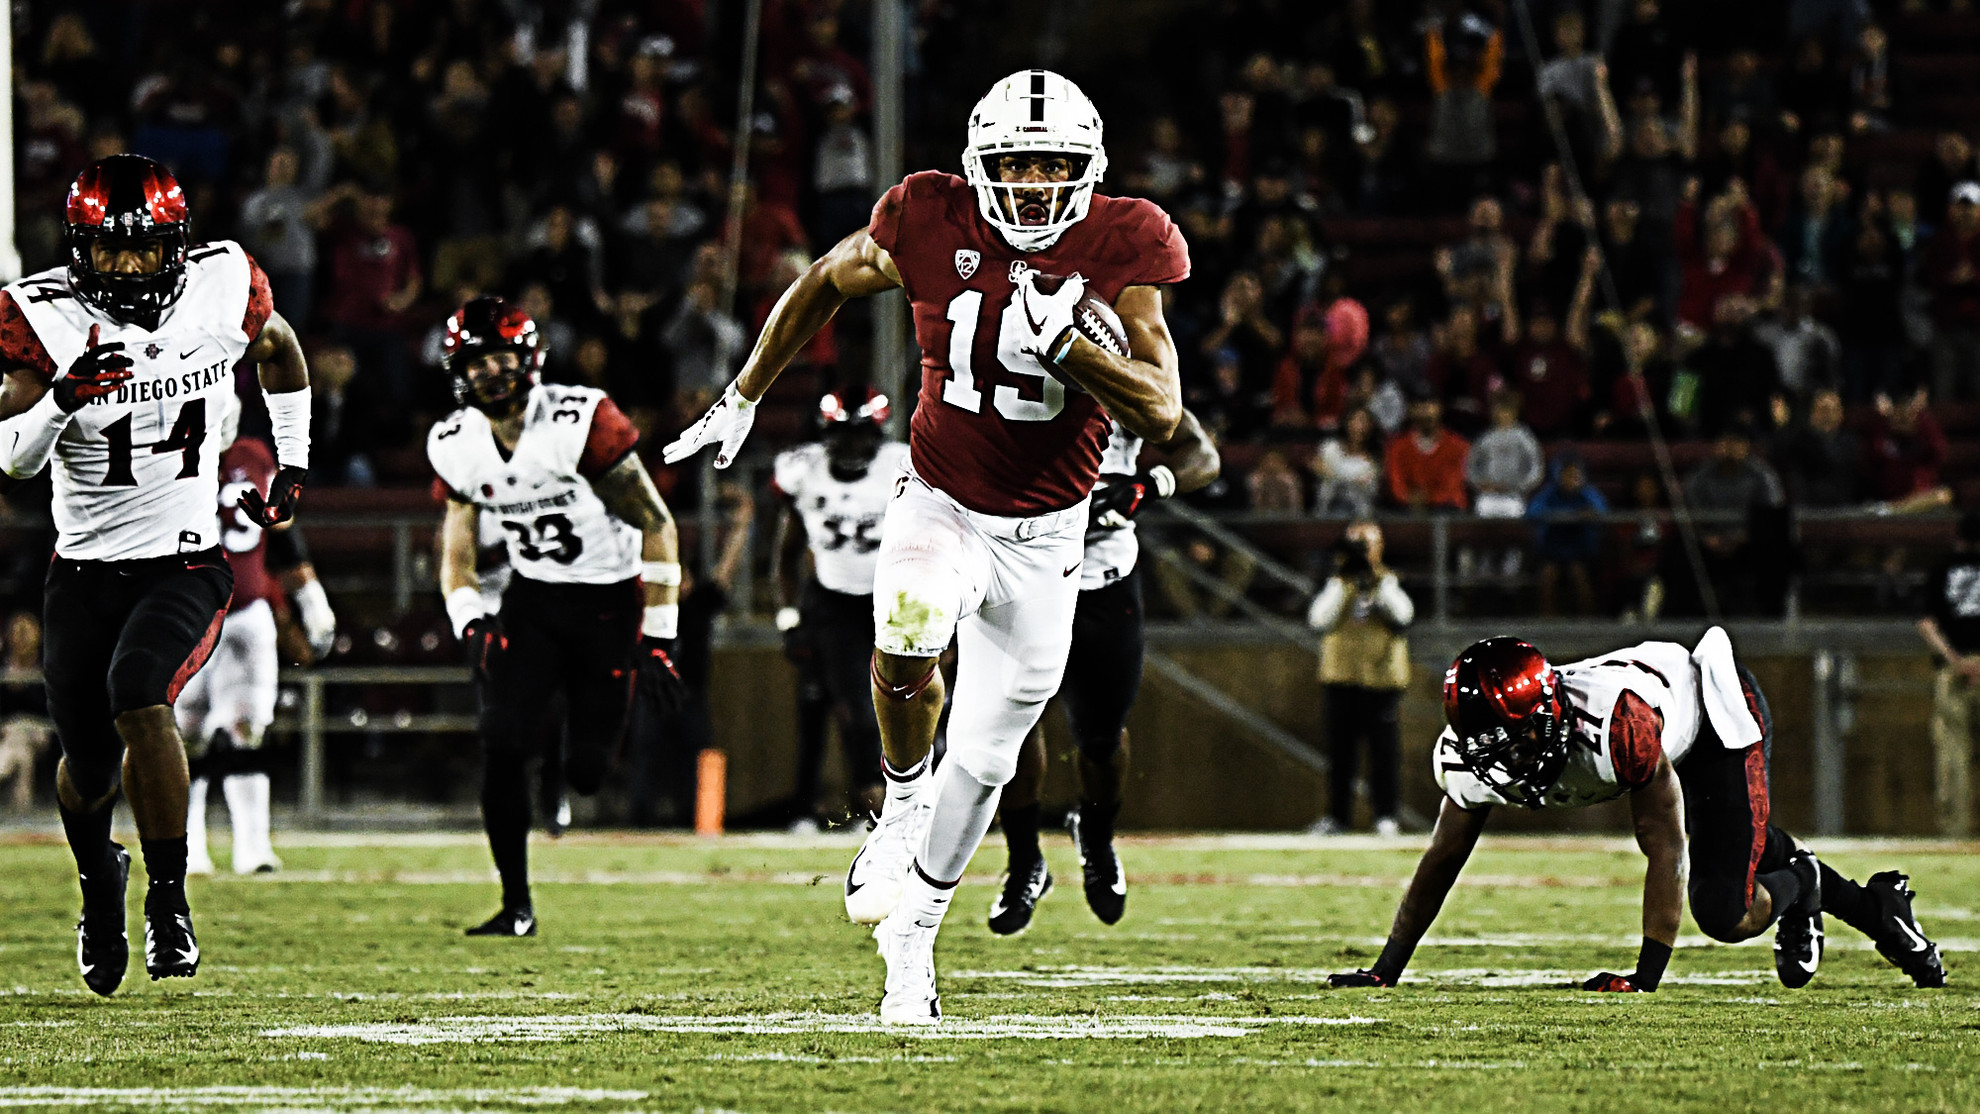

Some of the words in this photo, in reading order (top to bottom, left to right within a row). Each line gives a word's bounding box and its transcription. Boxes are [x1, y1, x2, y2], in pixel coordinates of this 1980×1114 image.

[116, 377, 178, 405] DIEGO
[182, 358, 229, 395] STATE
[98, 397, 208, 487] 14
